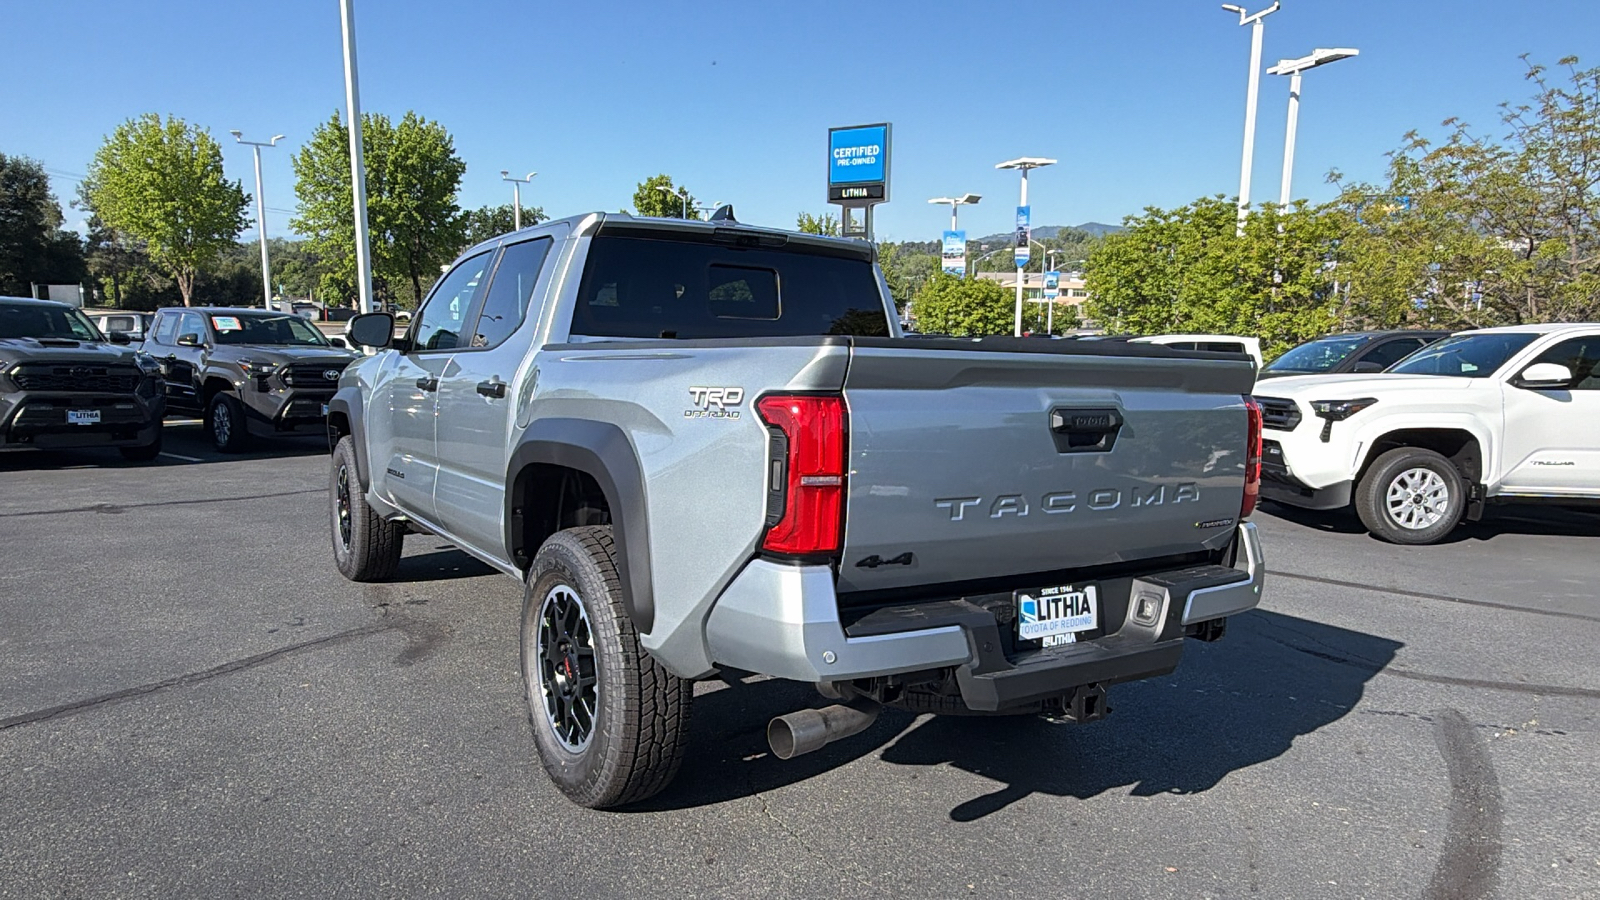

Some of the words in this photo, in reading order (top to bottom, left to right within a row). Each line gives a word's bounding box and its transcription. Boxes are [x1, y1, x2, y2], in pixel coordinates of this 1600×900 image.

[833, 145, 880, 158] CERTIFIED
[837, 157, 875, 167] PRE-OWNED
[842, 188, 868, 198] LITHIA
[689, 386, 744, 410] TRD
[1075, 416, 1107, 426] TOYOTA
[933, 481, 1201, 522] TACOMA
[1041, 586, 1059, 596] SINCE
[1037, 594, 1091, 621] LITHIA
[1021, 622, 1049, 634] TOYOTA
[1049, 620, 1059, 631] OF
[1060, 616, 1092, 629] REDDING
[1050, 632, 1076, 645] LITHIA
